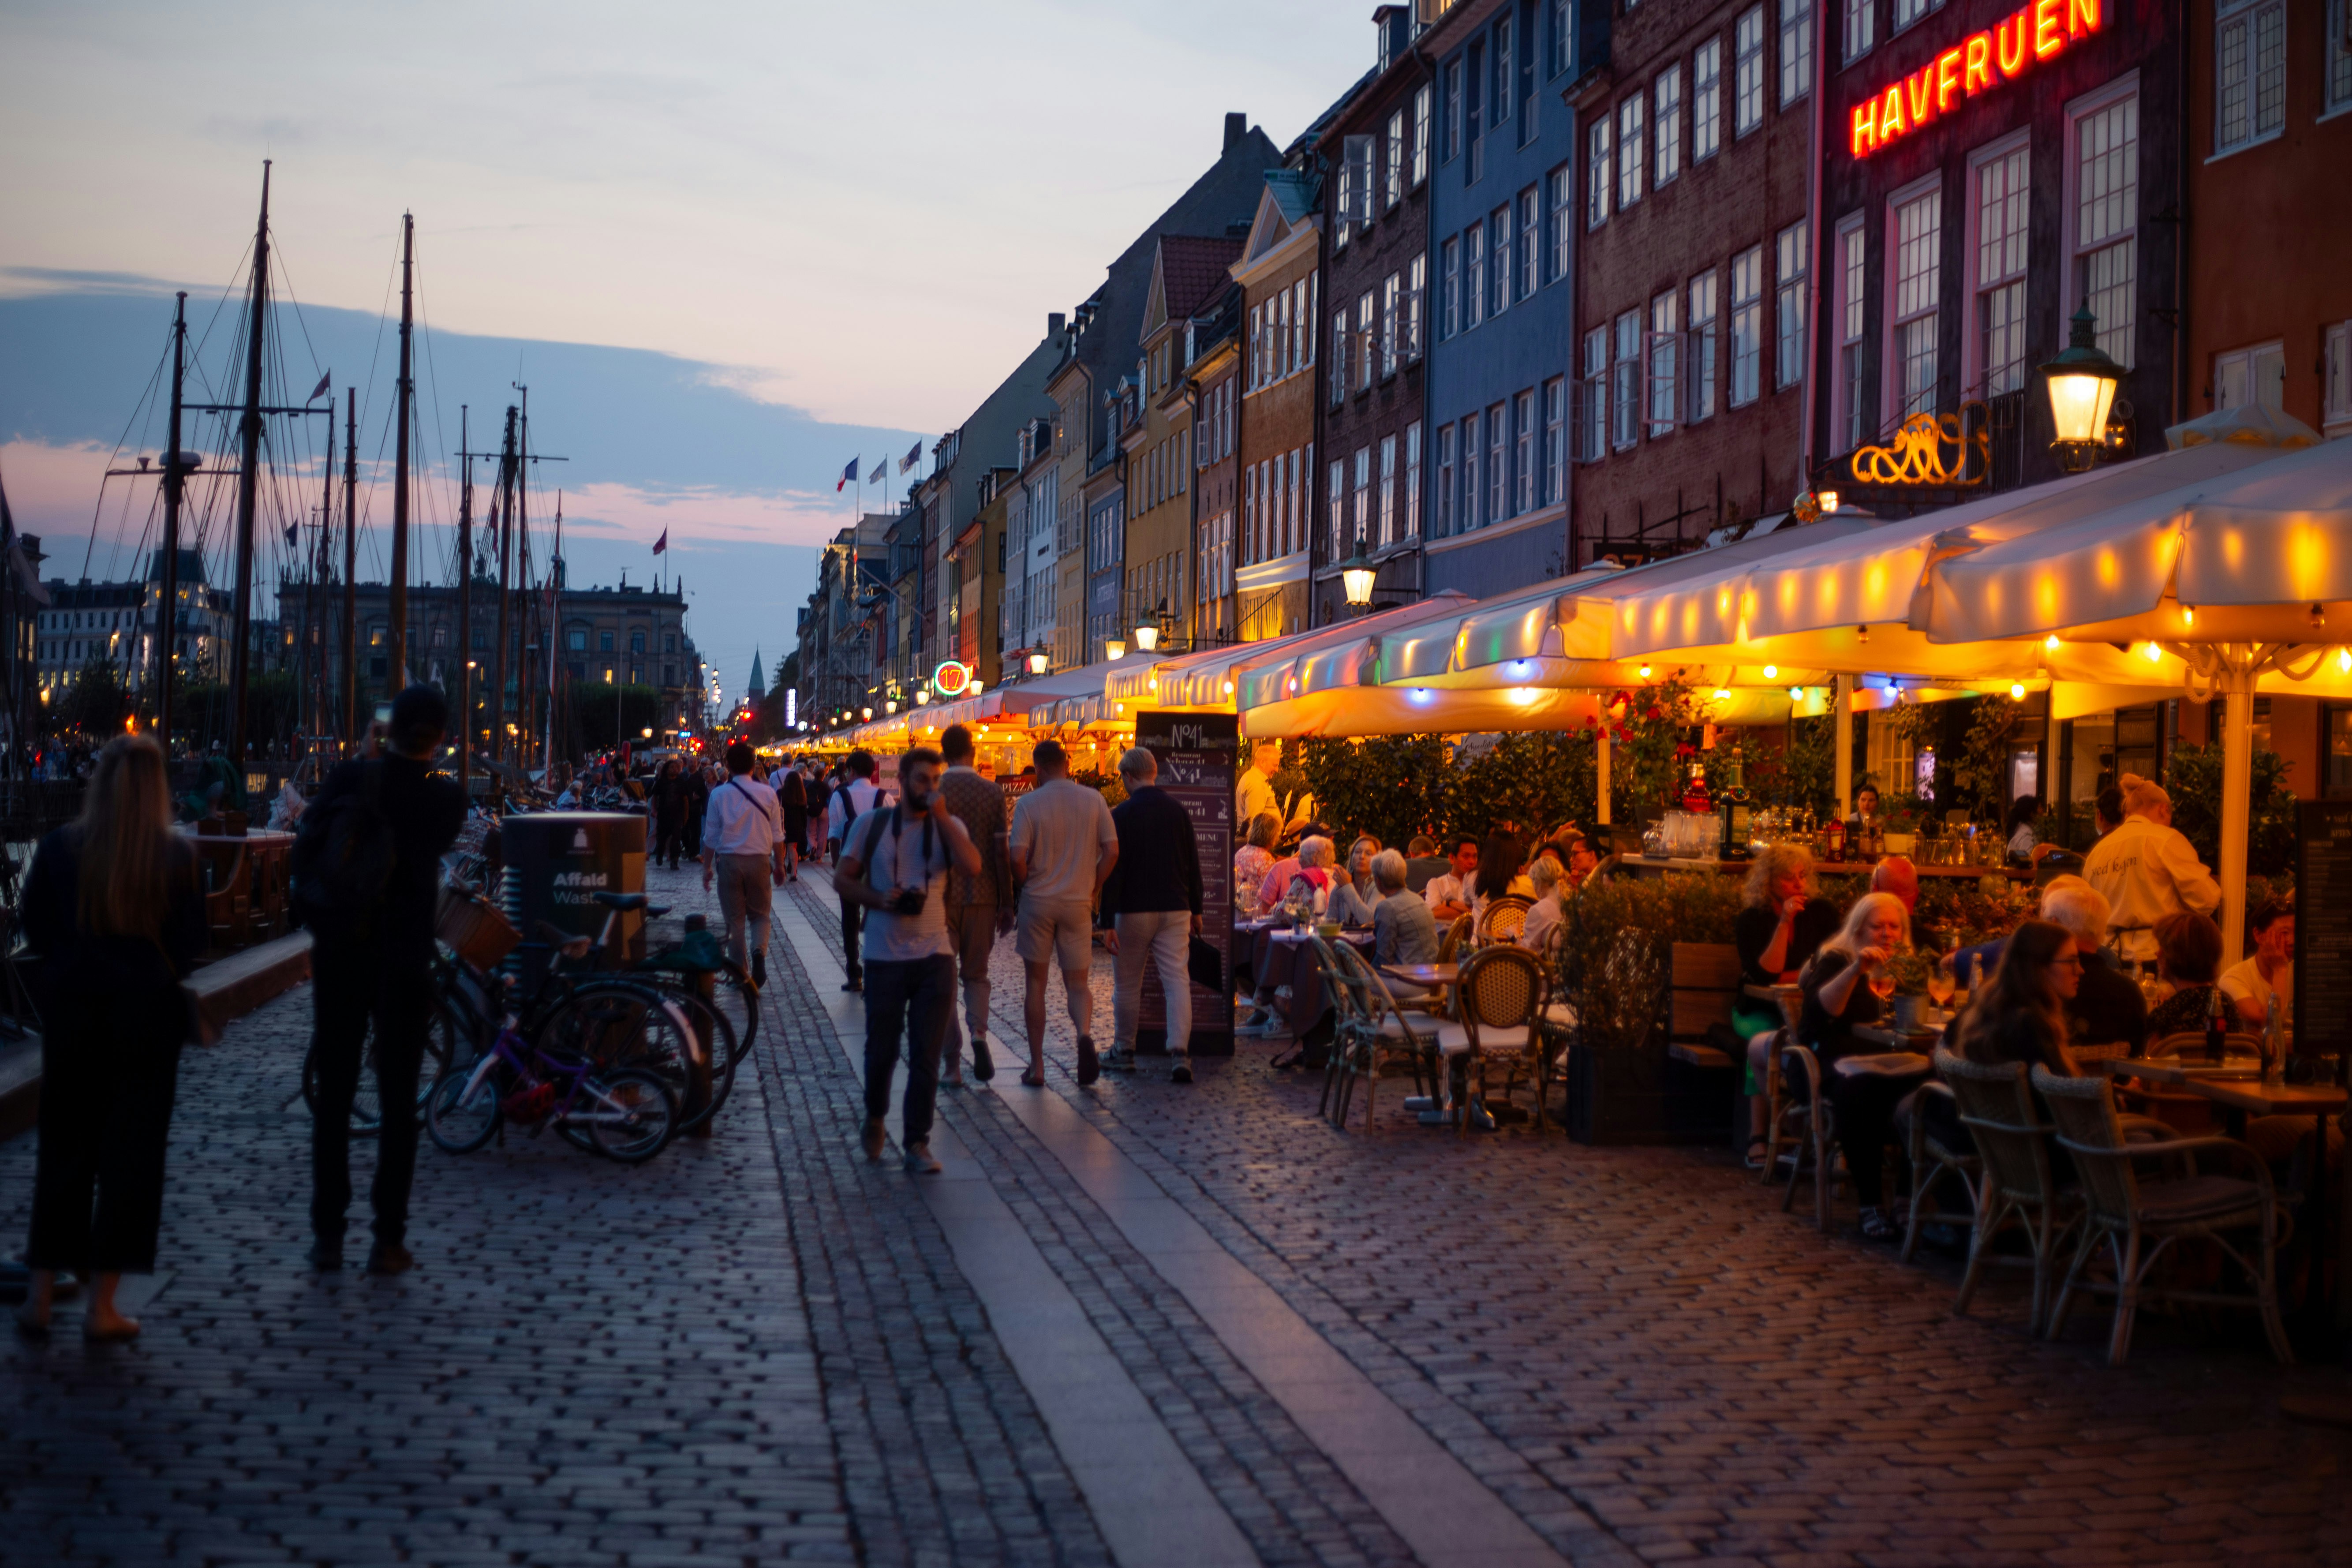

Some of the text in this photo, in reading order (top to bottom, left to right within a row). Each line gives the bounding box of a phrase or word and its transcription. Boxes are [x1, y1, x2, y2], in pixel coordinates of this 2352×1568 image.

[1850, 0, 2102, 159] HAVFRUEN
[940, 669, 961, 689] 17
[1002, 781, 1035, 792] PIZZA
[1196, 833, 1219, 842] MENU
[553, 872, 608, 887] Affald
[553, 891, 601, 905] Wast
